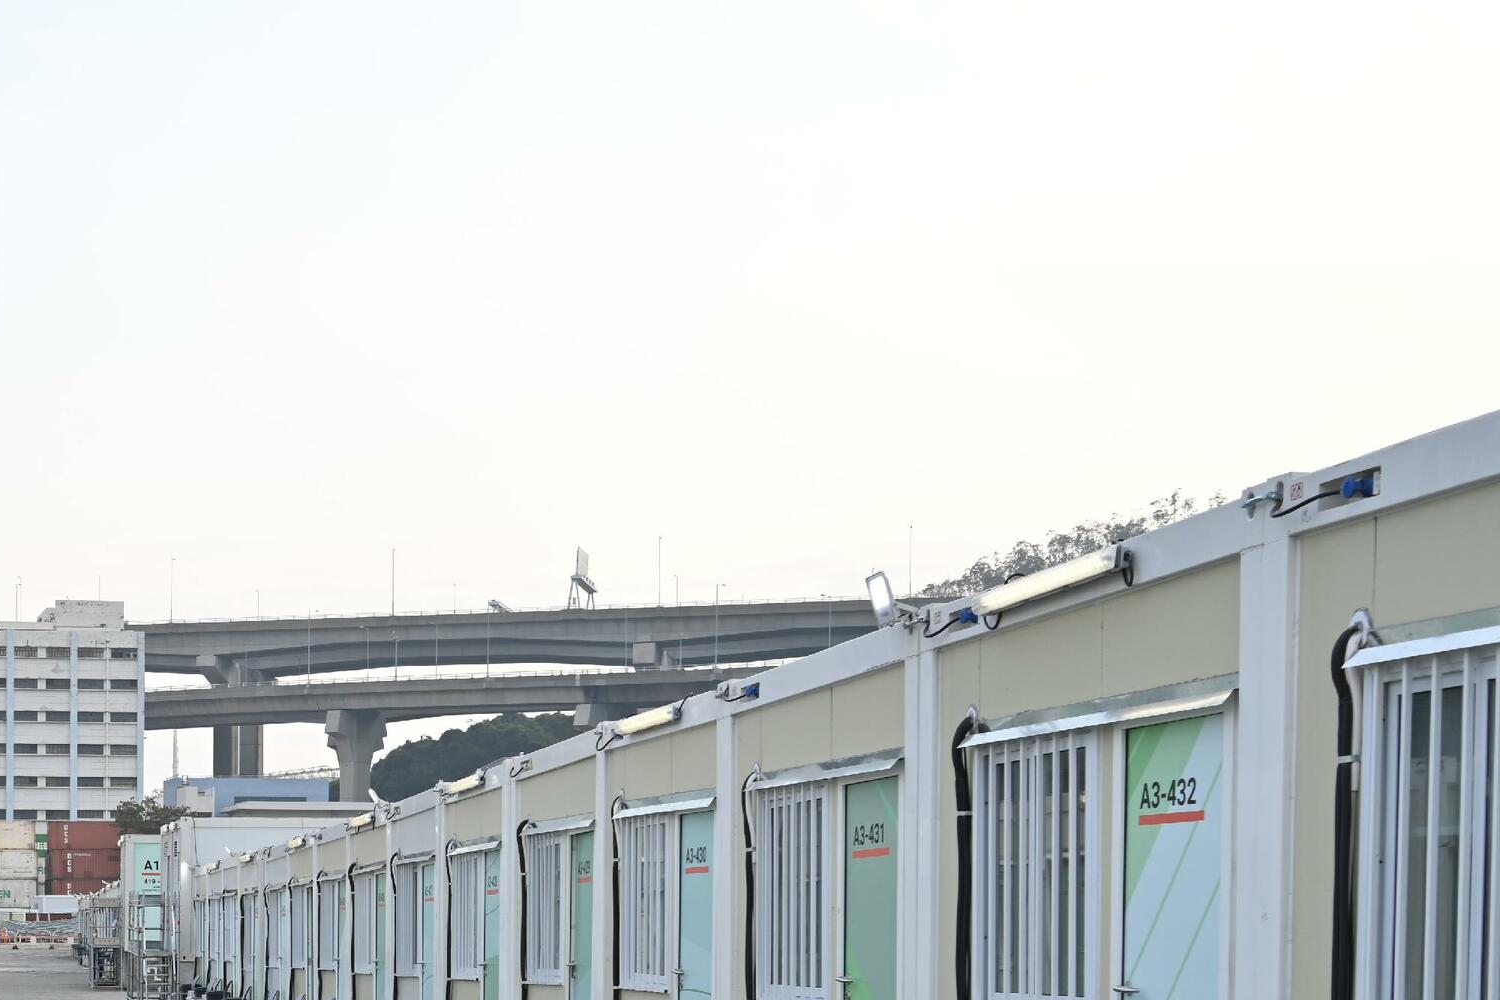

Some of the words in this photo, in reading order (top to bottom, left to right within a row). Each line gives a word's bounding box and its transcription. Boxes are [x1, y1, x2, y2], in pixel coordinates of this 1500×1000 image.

[1140, 777, 1197, 809] A3-432
[853, 822, 884, 846] A3-431
[144, 860, 159, 871] A1
[685, 846, 707, 864] A3-430
